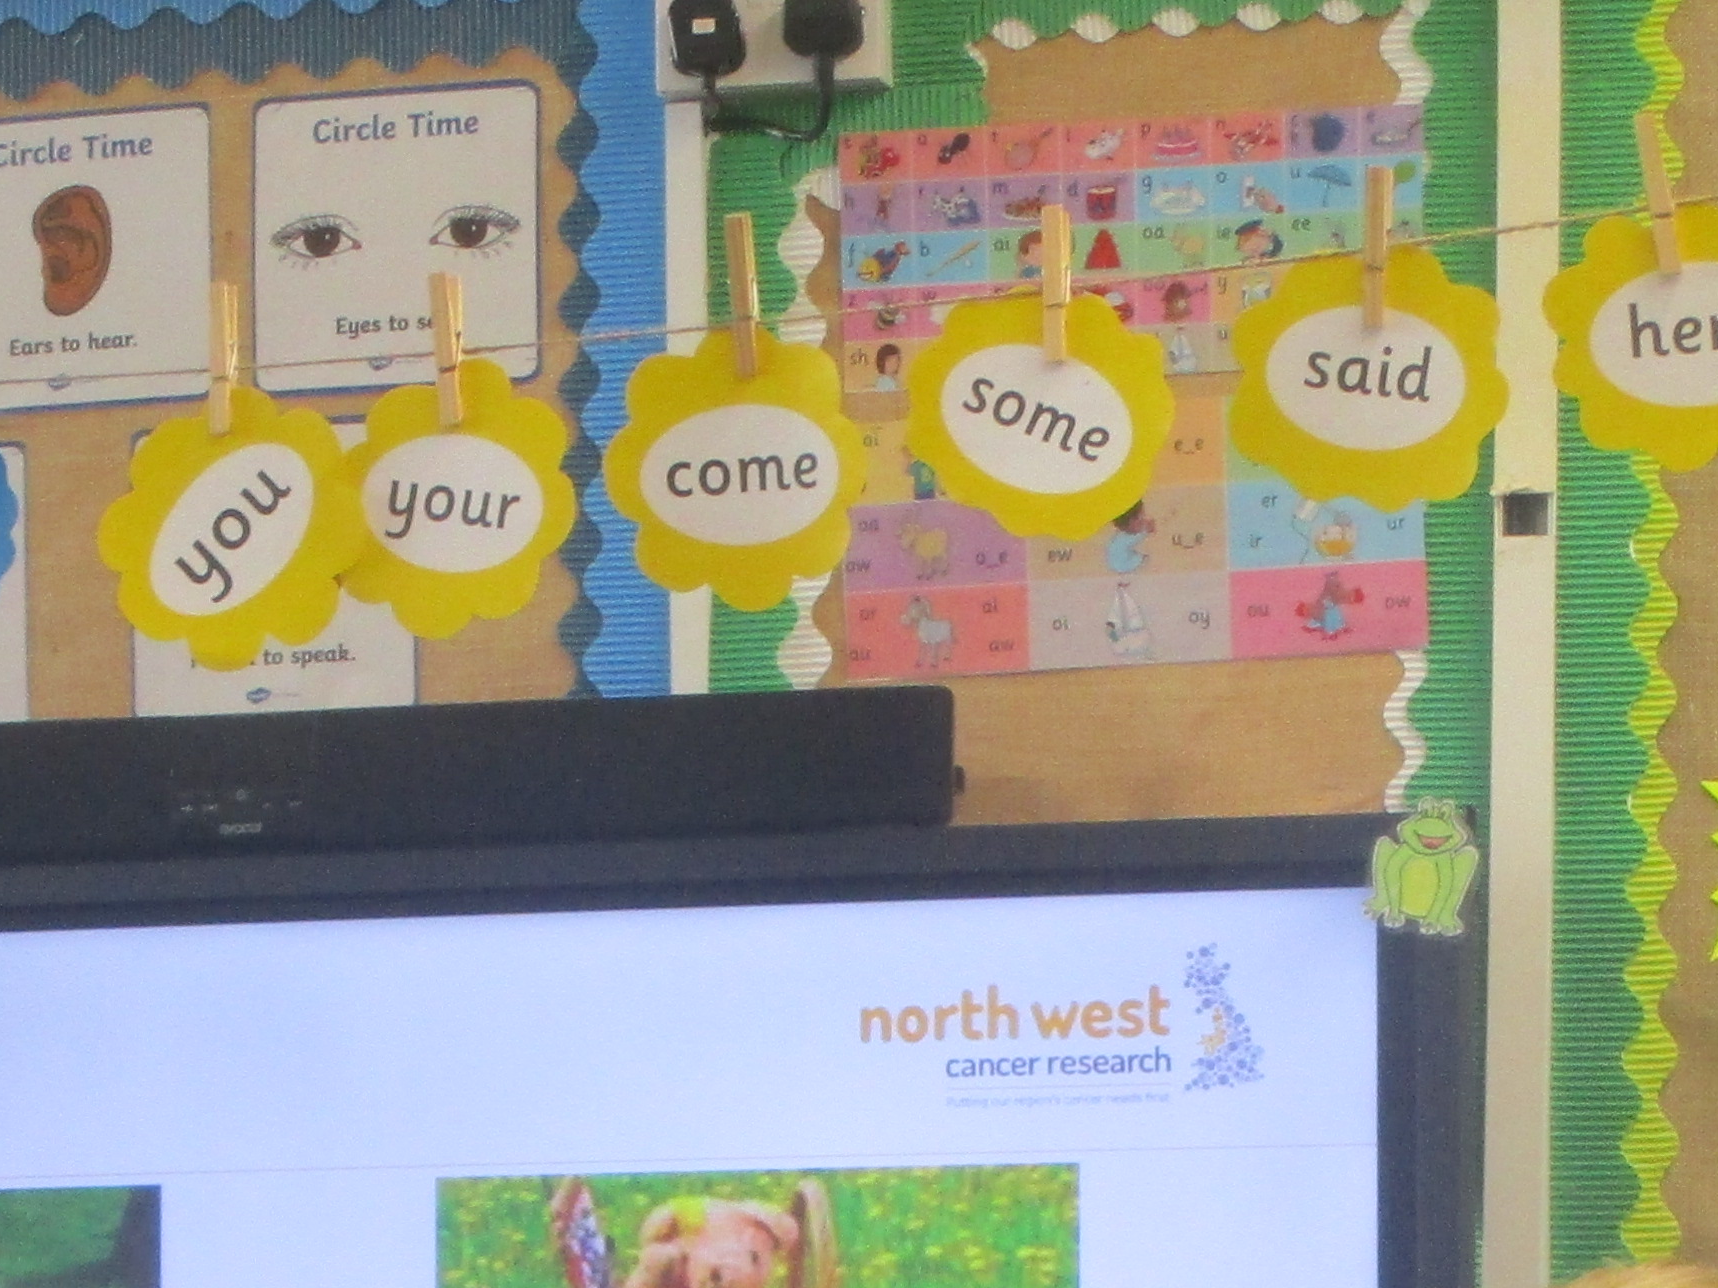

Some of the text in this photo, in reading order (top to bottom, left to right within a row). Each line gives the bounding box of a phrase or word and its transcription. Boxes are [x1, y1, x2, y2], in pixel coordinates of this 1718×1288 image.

[83, 133, 154, 160] Time
[312, 112, 479, 145] Circle Time
[9, 331, 137, 357] Ears to hear.
[335, 315, 381, 337] Eyes
[389, 313, 410, 332] to
[1304, 346, 1432, 403] said
[962, 377, 1111, 462] some
[666, 446, 819, 498] come
[383, 478, 521, 541] your
[174, 468, 293, 604] you
[263, 646, 284, 665] to
[291, 642, 357, 669] speak.
[859, 982, 1171, 1044] north west
[946, 1046, 1171, 1078] cancer research
